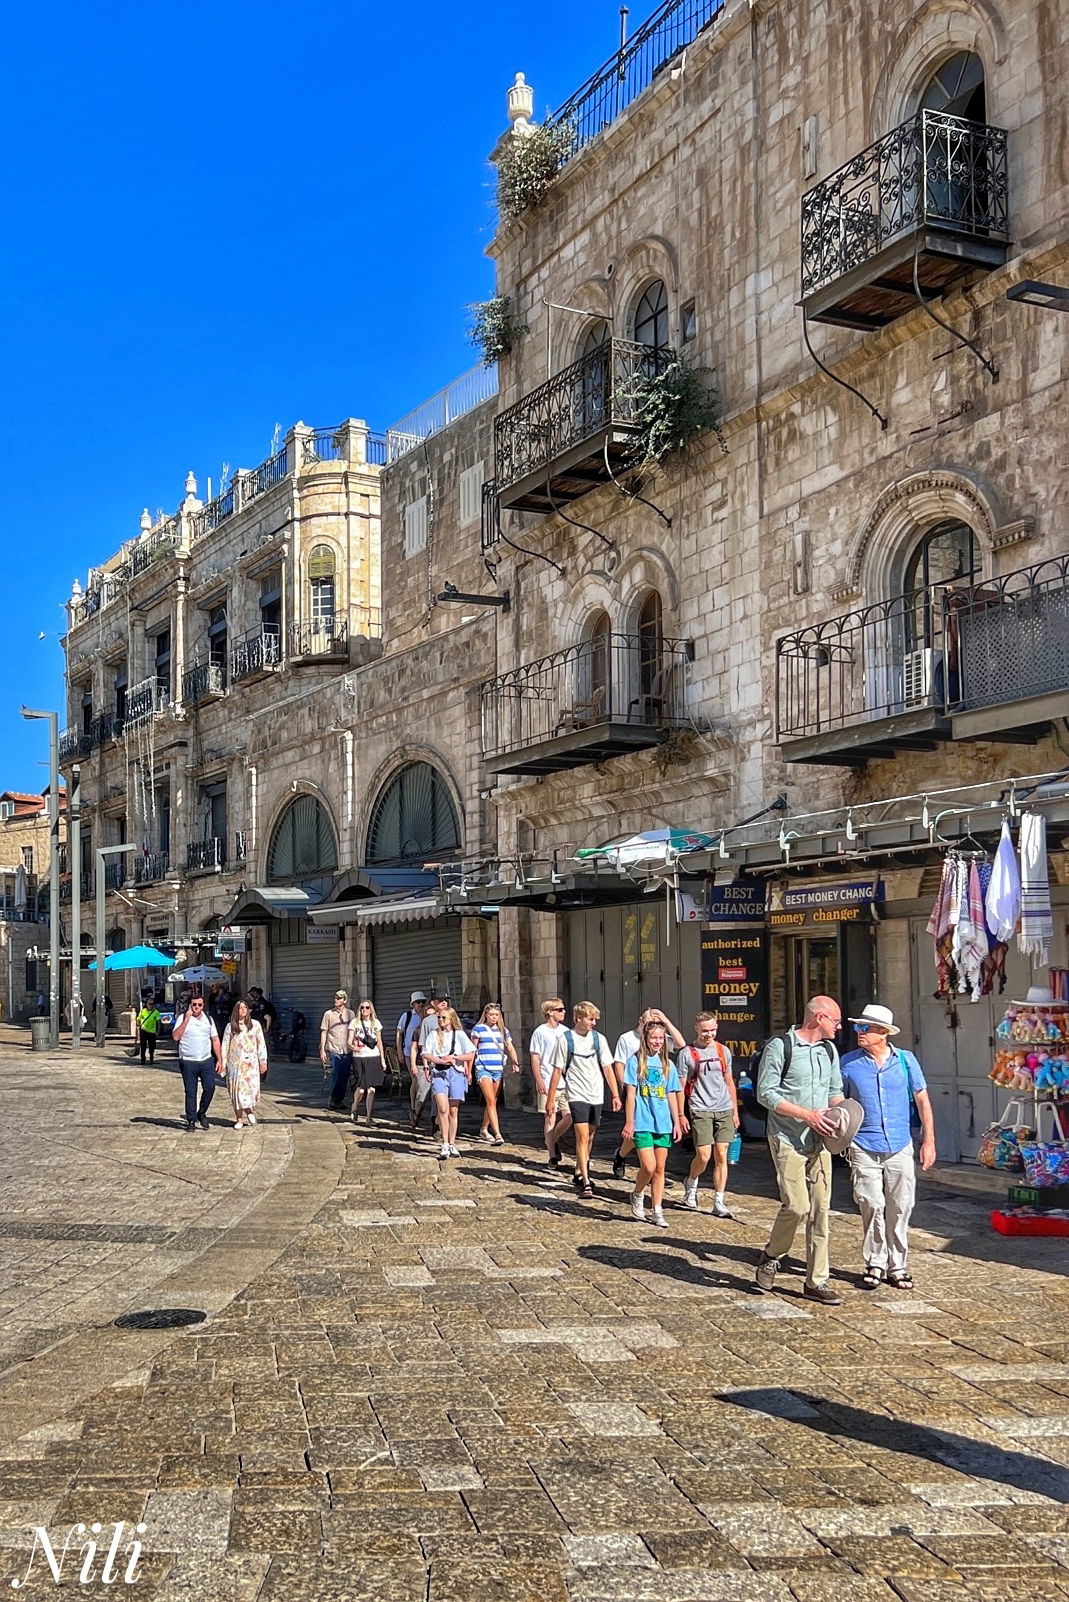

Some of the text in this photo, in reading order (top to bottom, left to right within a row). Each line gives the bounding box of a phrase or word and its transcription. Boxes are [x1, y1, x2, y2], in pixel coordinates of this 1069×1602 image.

[724, 887, 755, 899] BEST
[786, 886, 878, 905] BEST MONEY CHANG
[711, 903, 764, 915] CHANGE
[771, 907, 860, 925] money changer
[702, 937, 761, 949] authorized
[718, 957, 743, 967] best
[704, 982, 760, 997] money
[714, 1009, 755, 1022] hanger
[725, 1040, 757, 1057] TM
